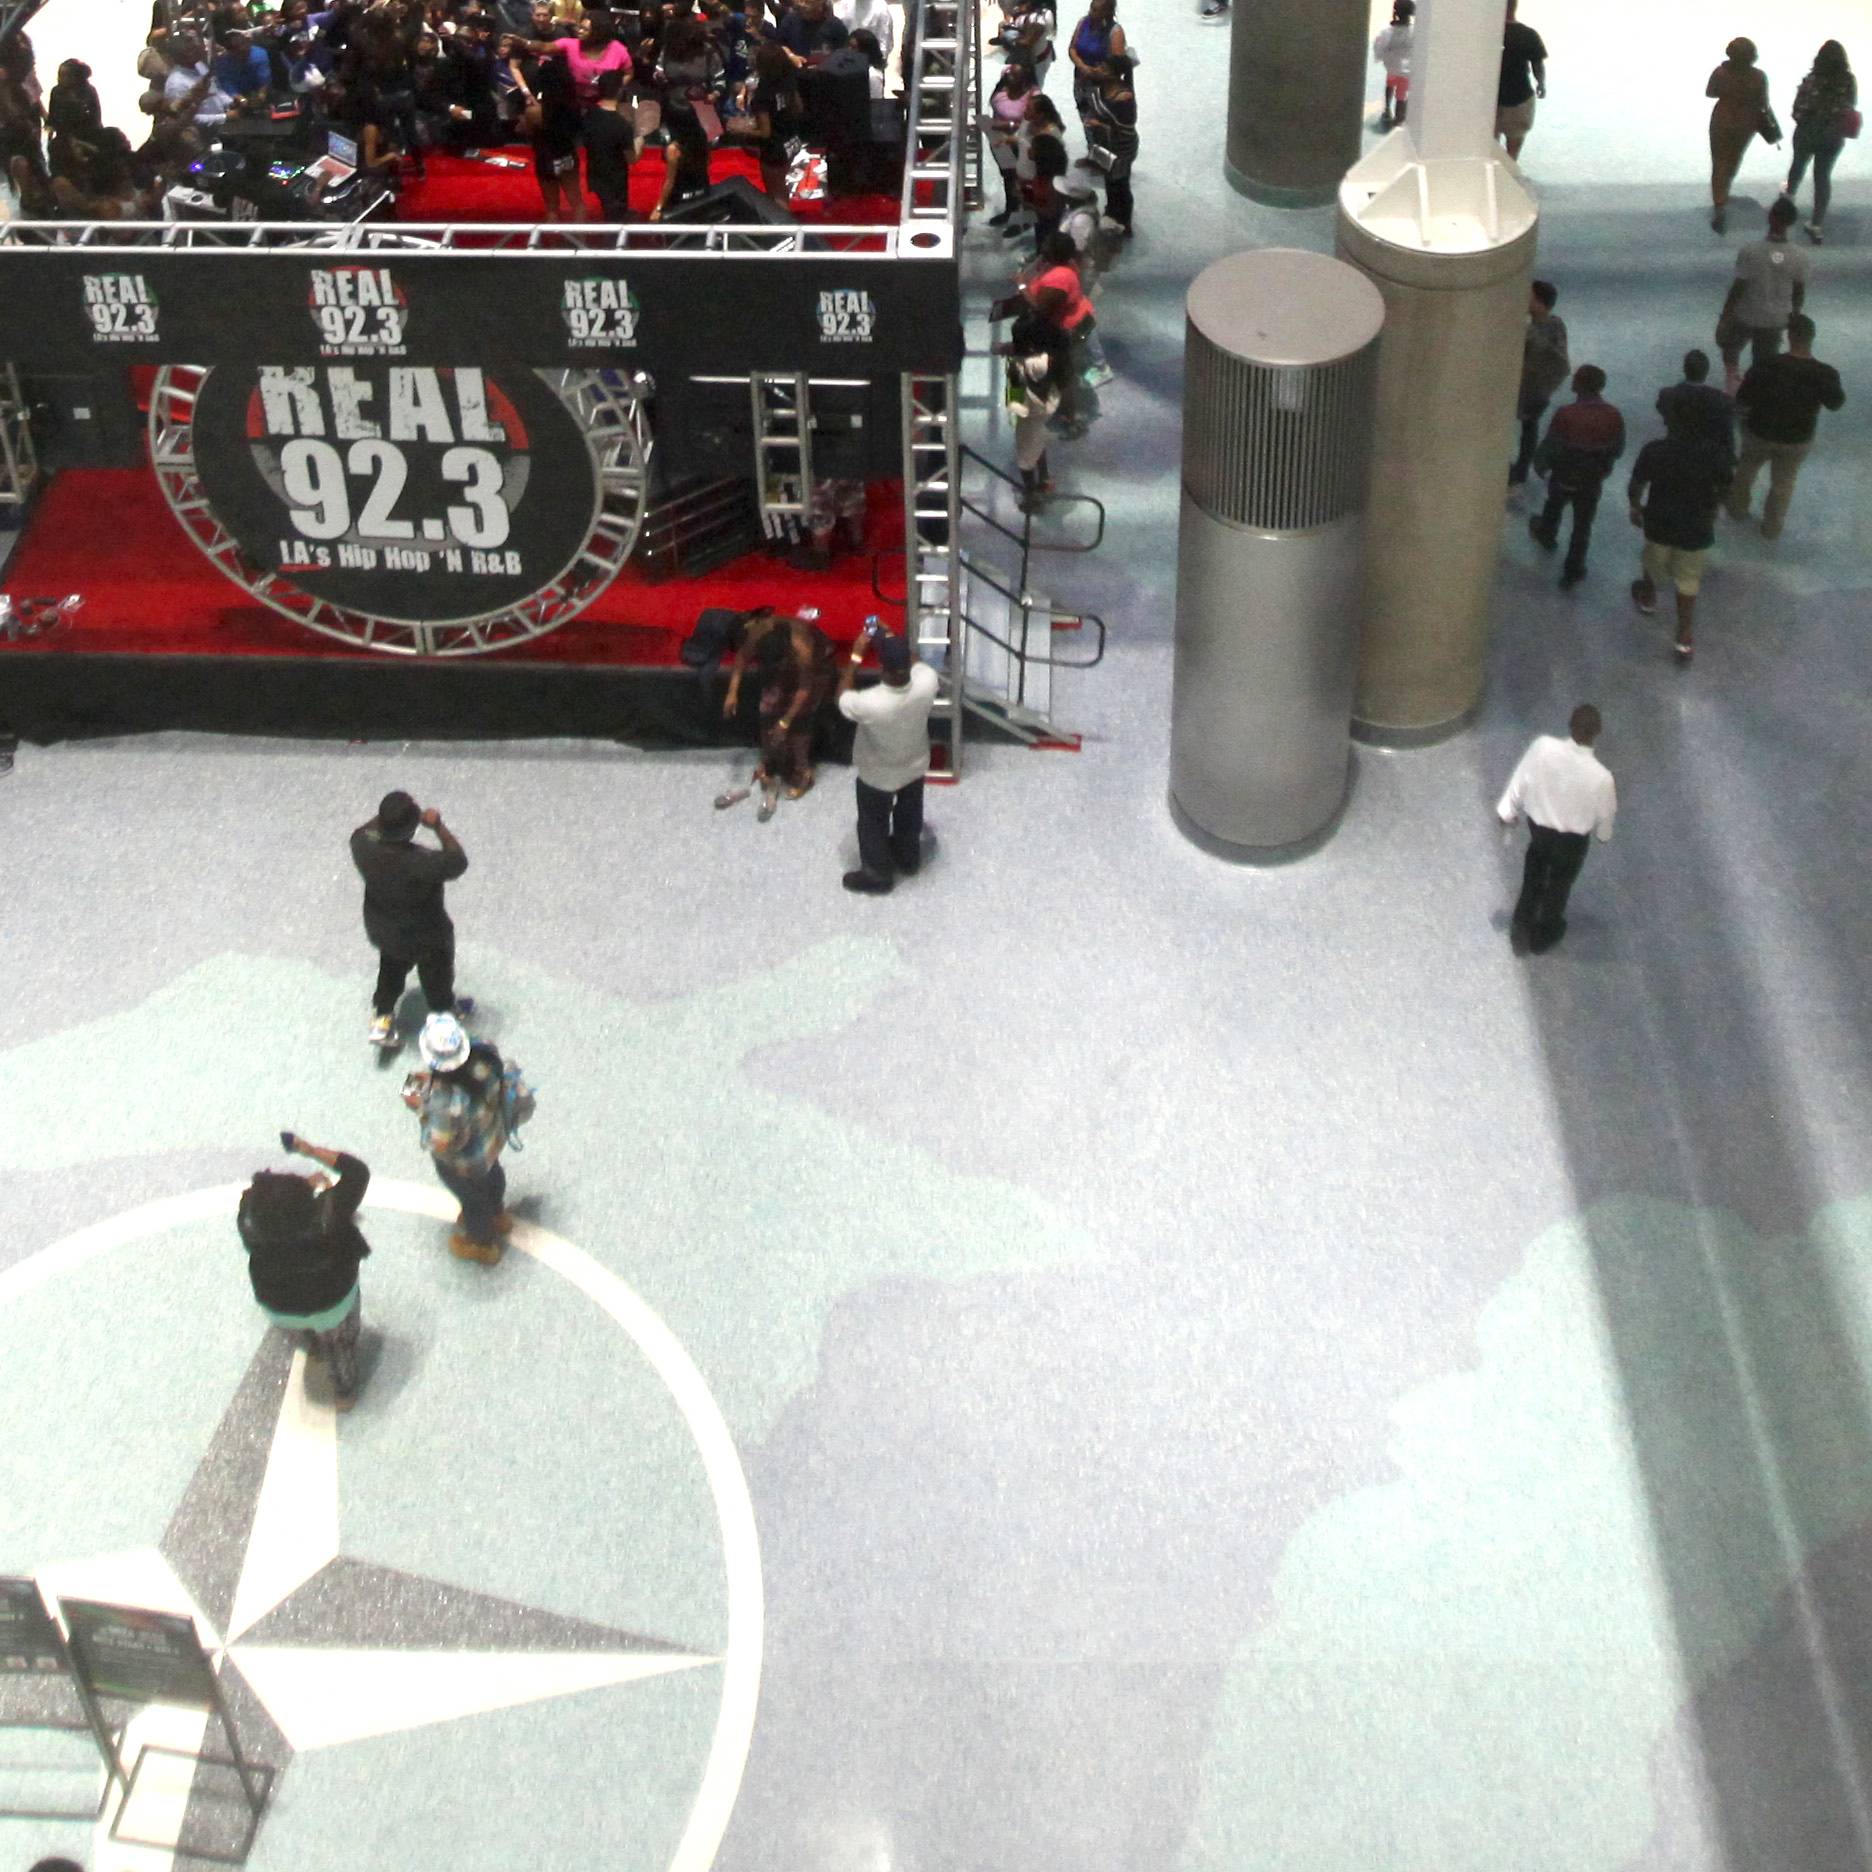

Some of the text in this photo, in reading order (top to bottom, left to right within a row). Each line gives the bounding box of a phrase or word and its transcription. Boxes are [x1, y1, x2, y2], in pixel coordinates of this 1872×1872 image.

[83, 275, 151, 304] REAL
[311, 268, 400, 306] REAL
[564, 279, 633, 309] REAL
[820, 291, 870, 313] REAL
[92, 303, 155, 333] 92.3
[321, 306, 402, 345] 92.3
[570, 308, 634, 339] 92.3
[823, 312, 870, 336] 92.3
[257, 366, 506, 442] REAL
[280, 438, 511, 548] 92.3
[279, 540, 523, 576] LA's Hip Hop 'N R&B
